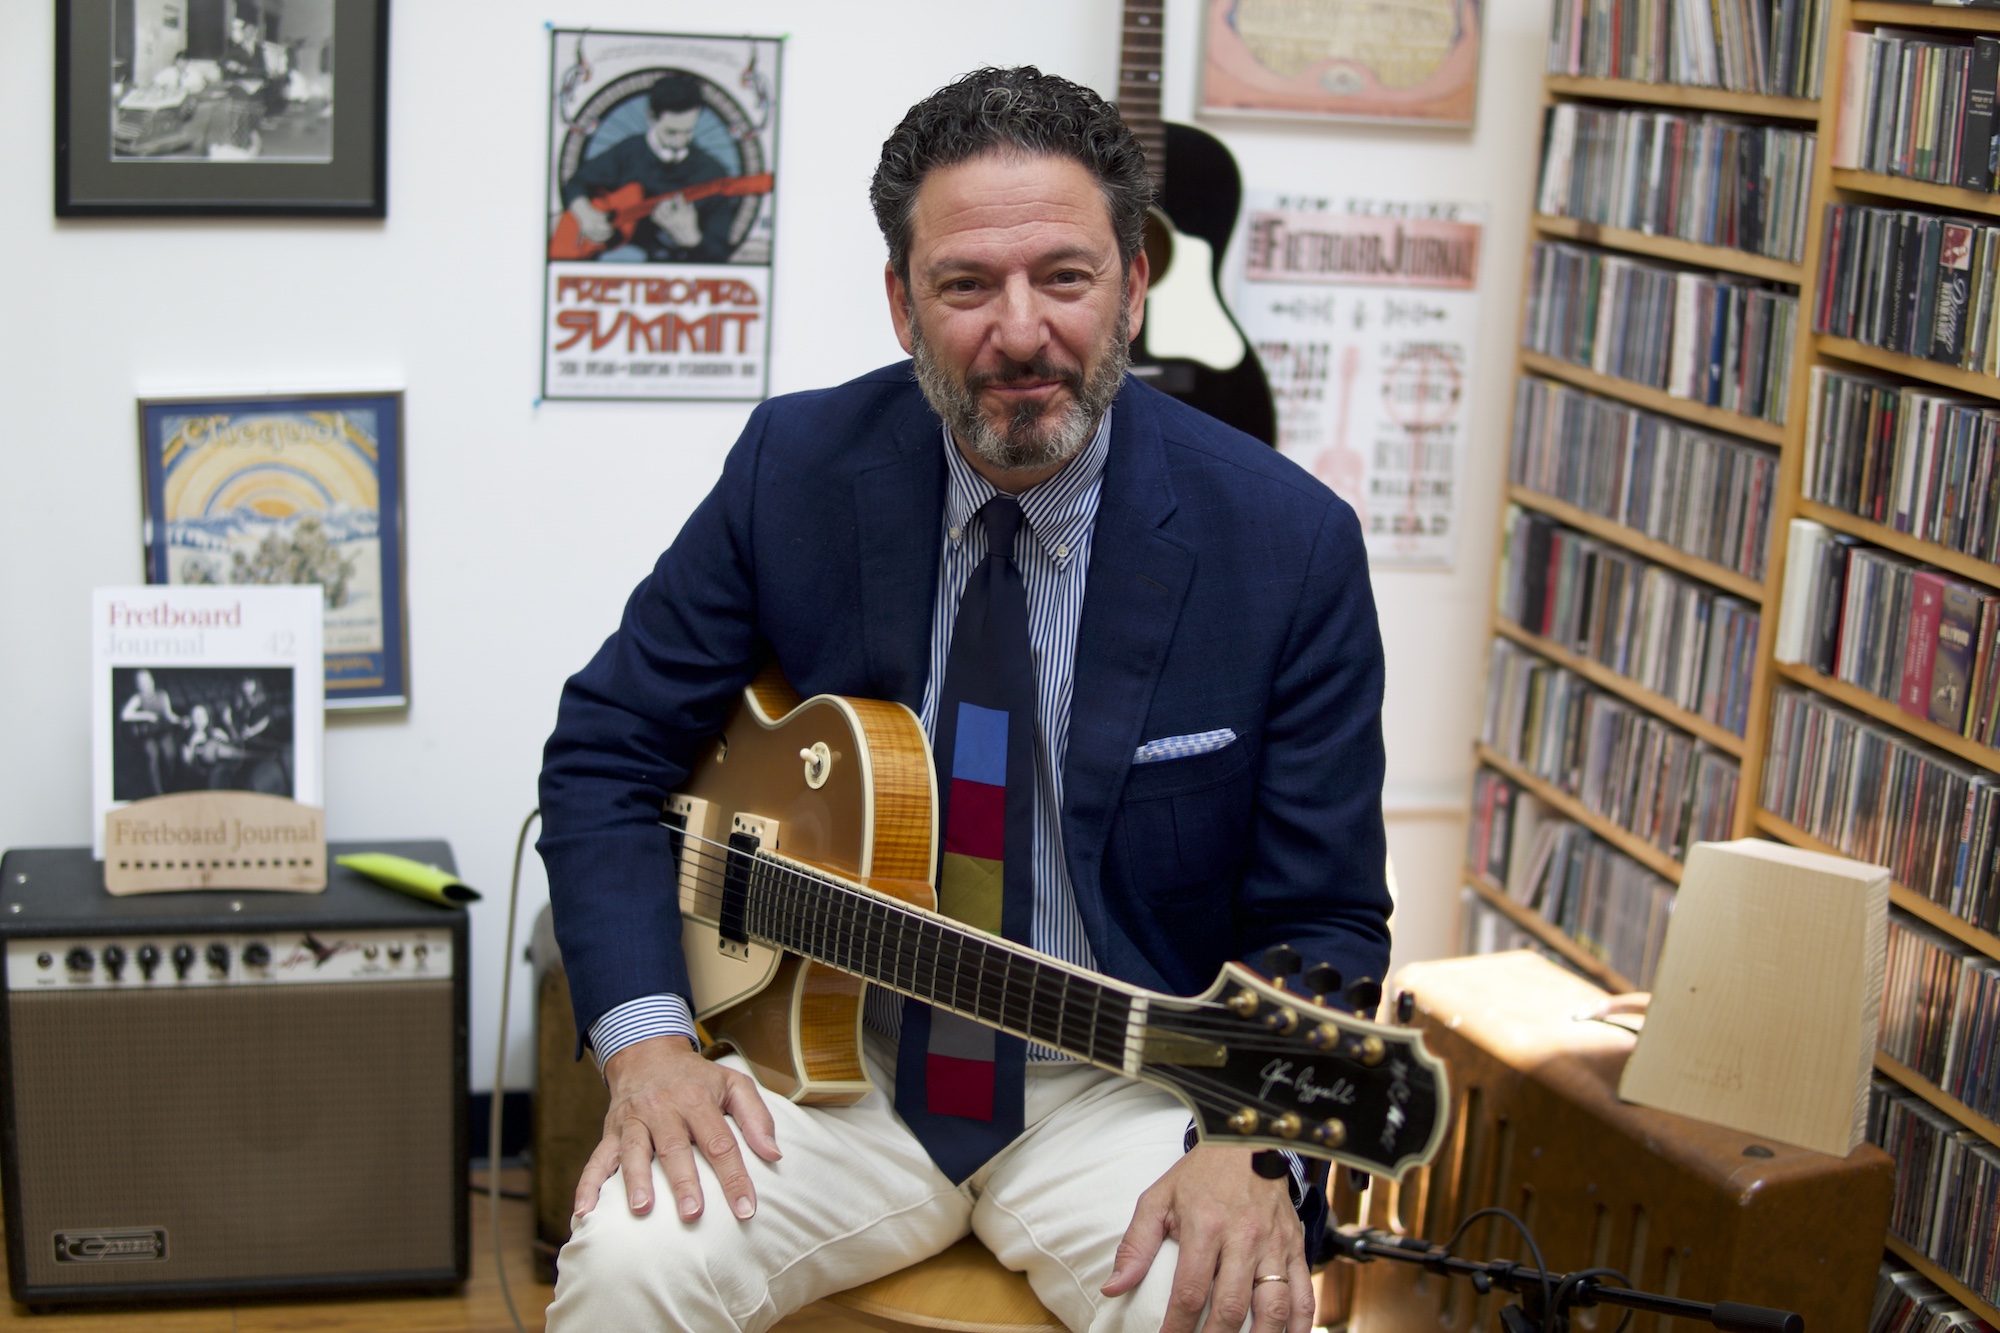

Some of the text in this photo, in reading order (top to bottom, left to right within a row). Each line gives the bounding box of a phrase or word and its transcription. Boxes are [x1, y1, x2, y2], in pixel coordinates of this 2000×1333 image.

[555, 310, 759, 354] SUMMIT
[109, 601, 243, 629] Fretboard
[103, 631, 206, 658] Journal
[114, 818, 318, 853] Fretboard Journal
